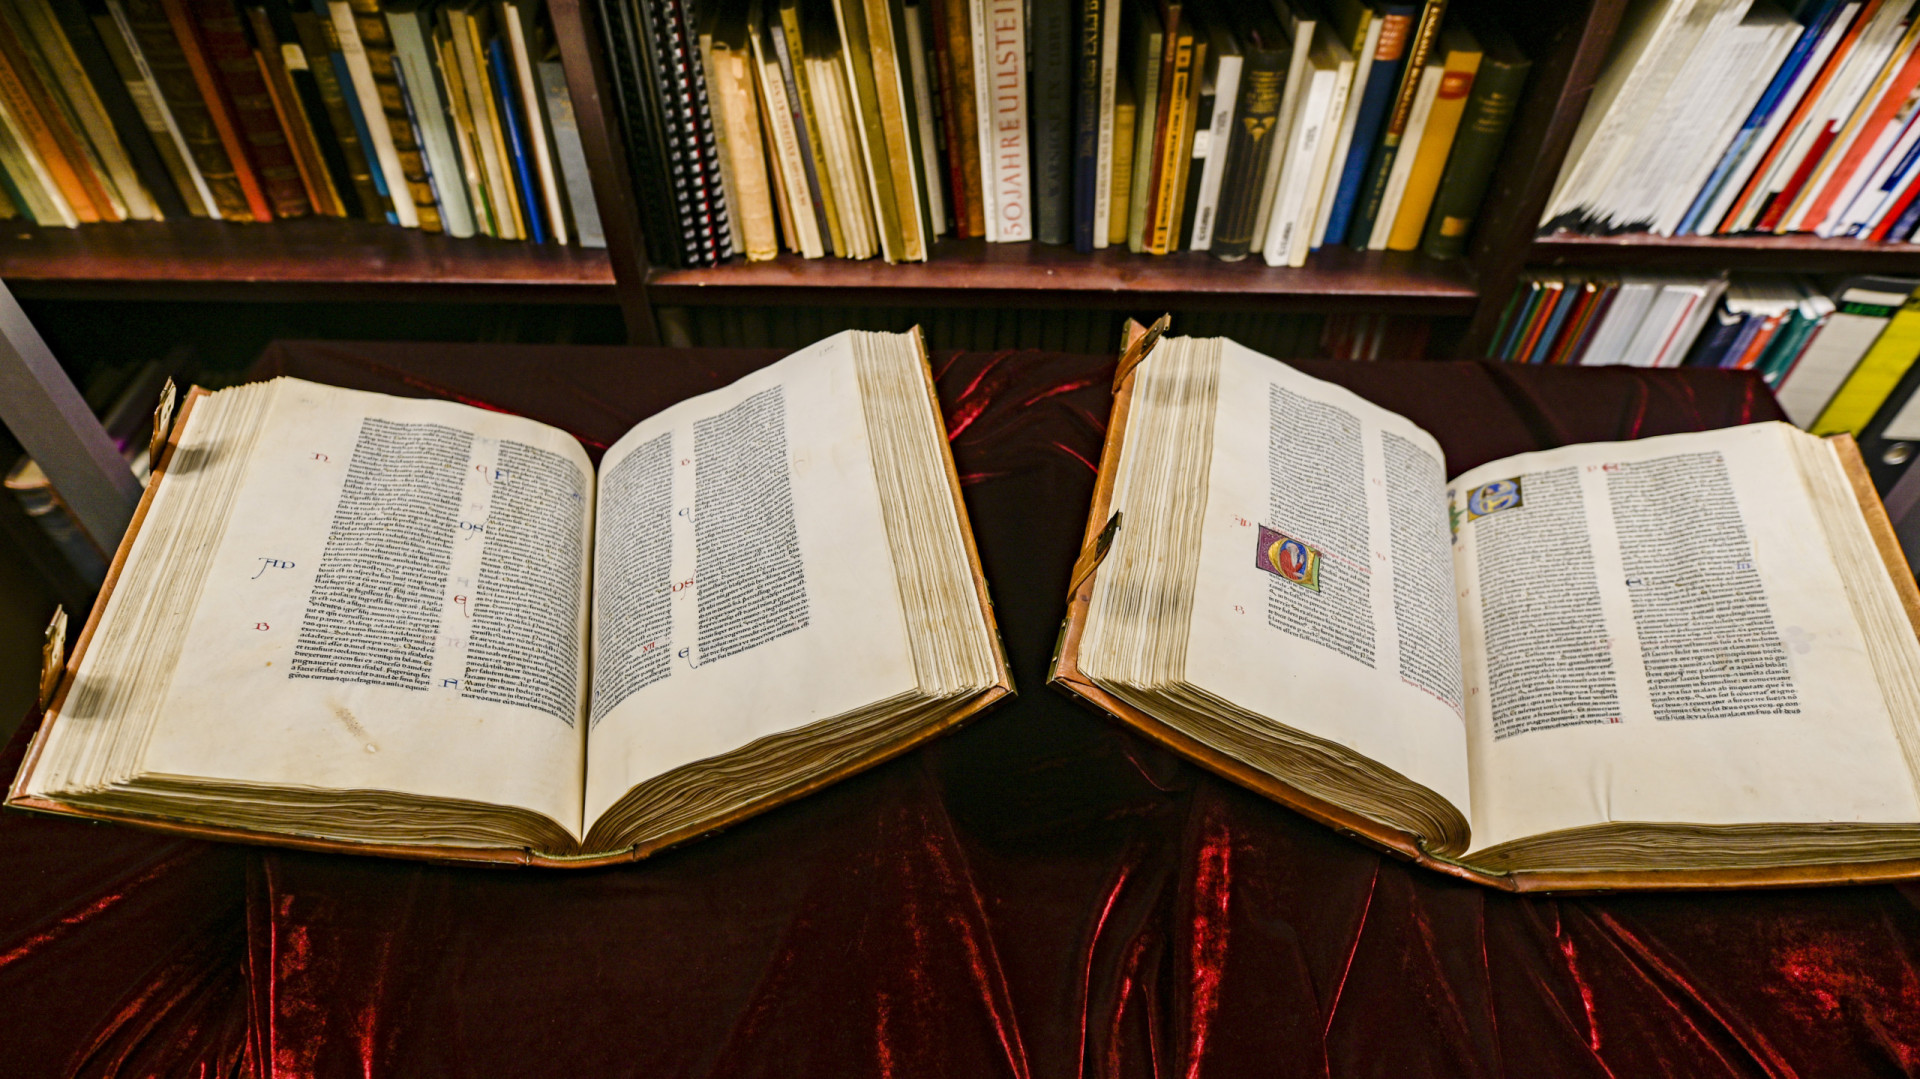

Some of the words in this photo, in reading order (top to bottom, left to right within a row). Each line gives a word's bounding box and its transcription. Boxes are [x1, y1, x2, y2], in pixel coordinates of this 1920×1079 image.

[993, 0, 1020, 114] ULLSTEI
[999, 117, 1023, 198] JAHRE
[1003, 201, 1025, 236] 50
